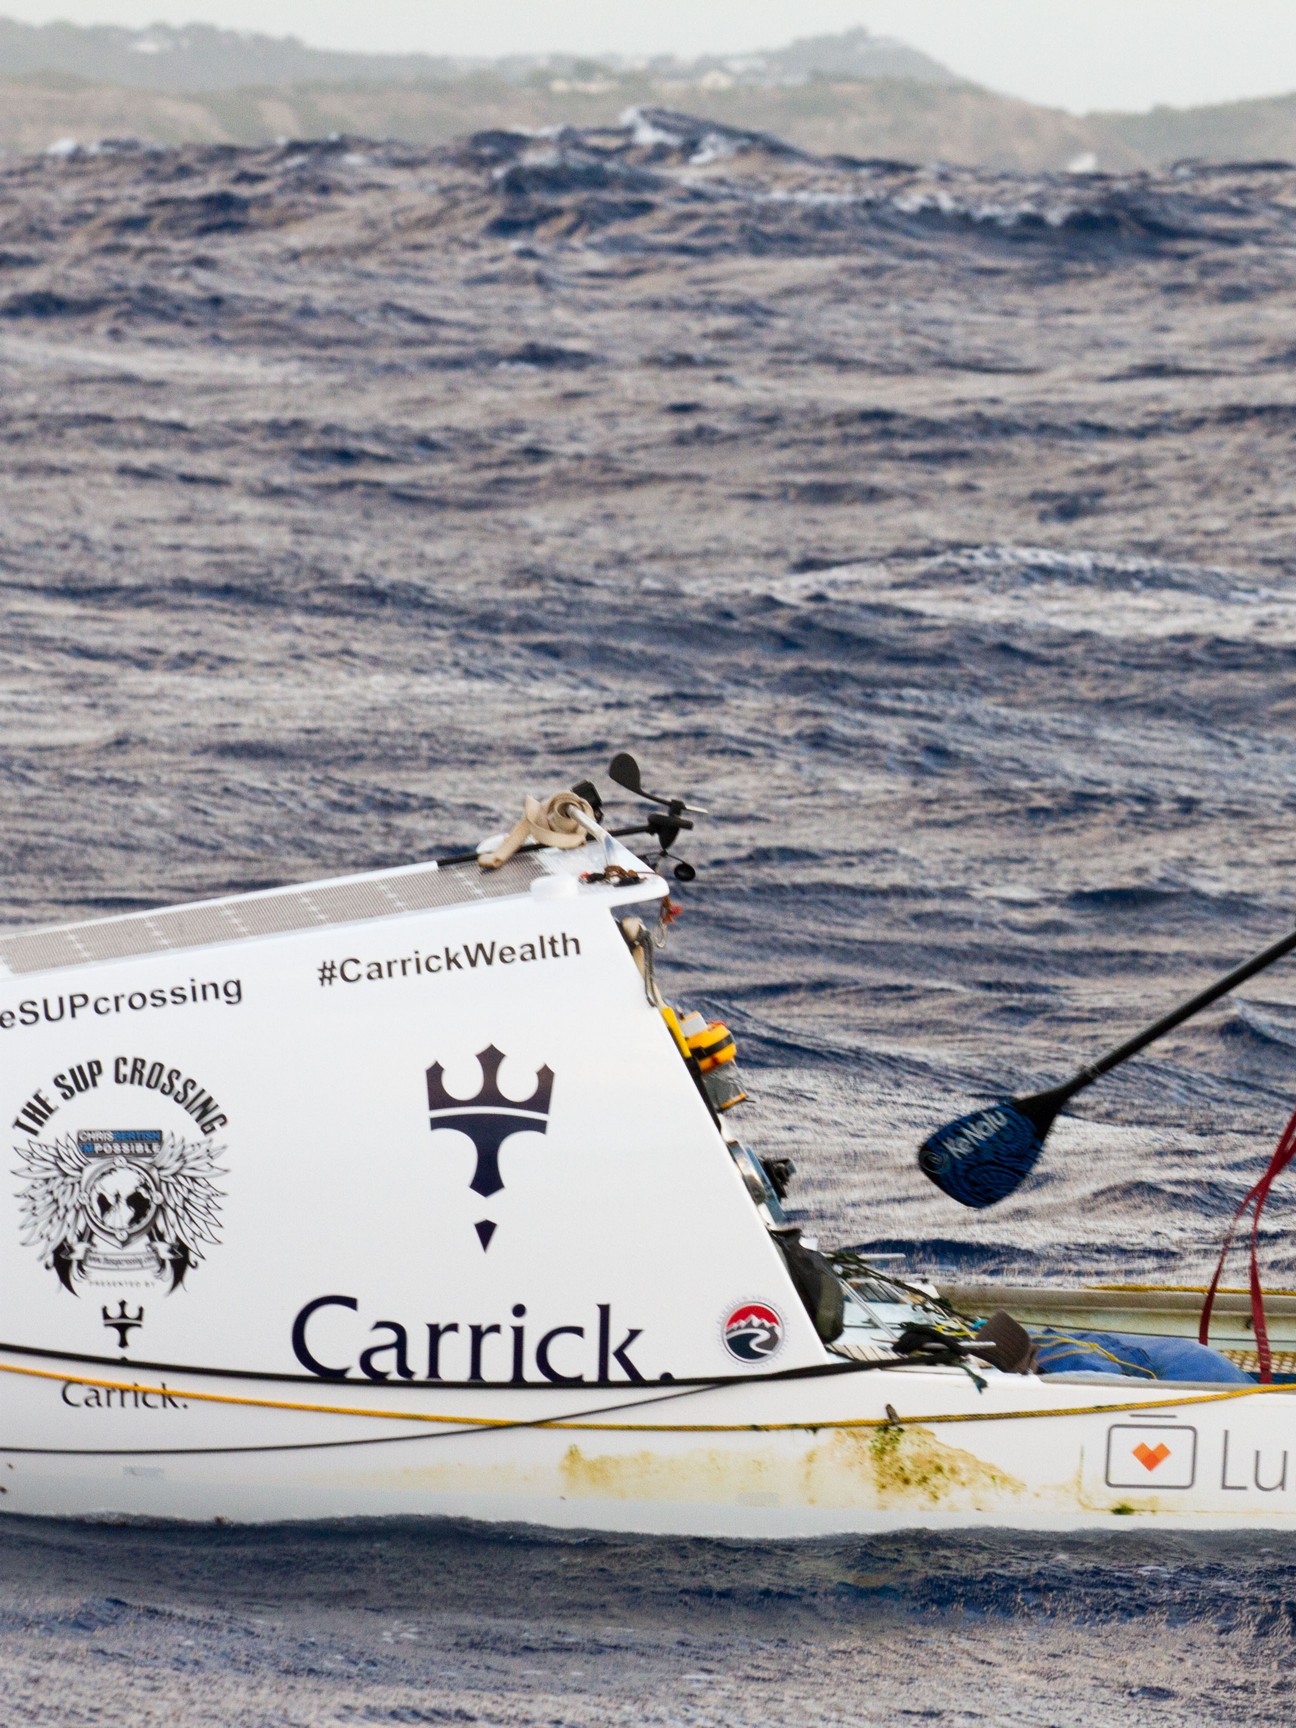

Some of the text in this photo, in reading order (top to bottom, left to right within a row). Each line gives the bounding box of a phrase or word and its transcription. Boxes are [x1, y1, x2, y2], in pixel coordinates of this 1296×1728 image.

[317, 932, 582, 986] #CarrickWealth
[0, 978, 243, 1029] eSUPcrossing
[12, 1056, 228, 1136] THE SUP CROSSING
[291, 1294, 676, 1385] Carrick.
